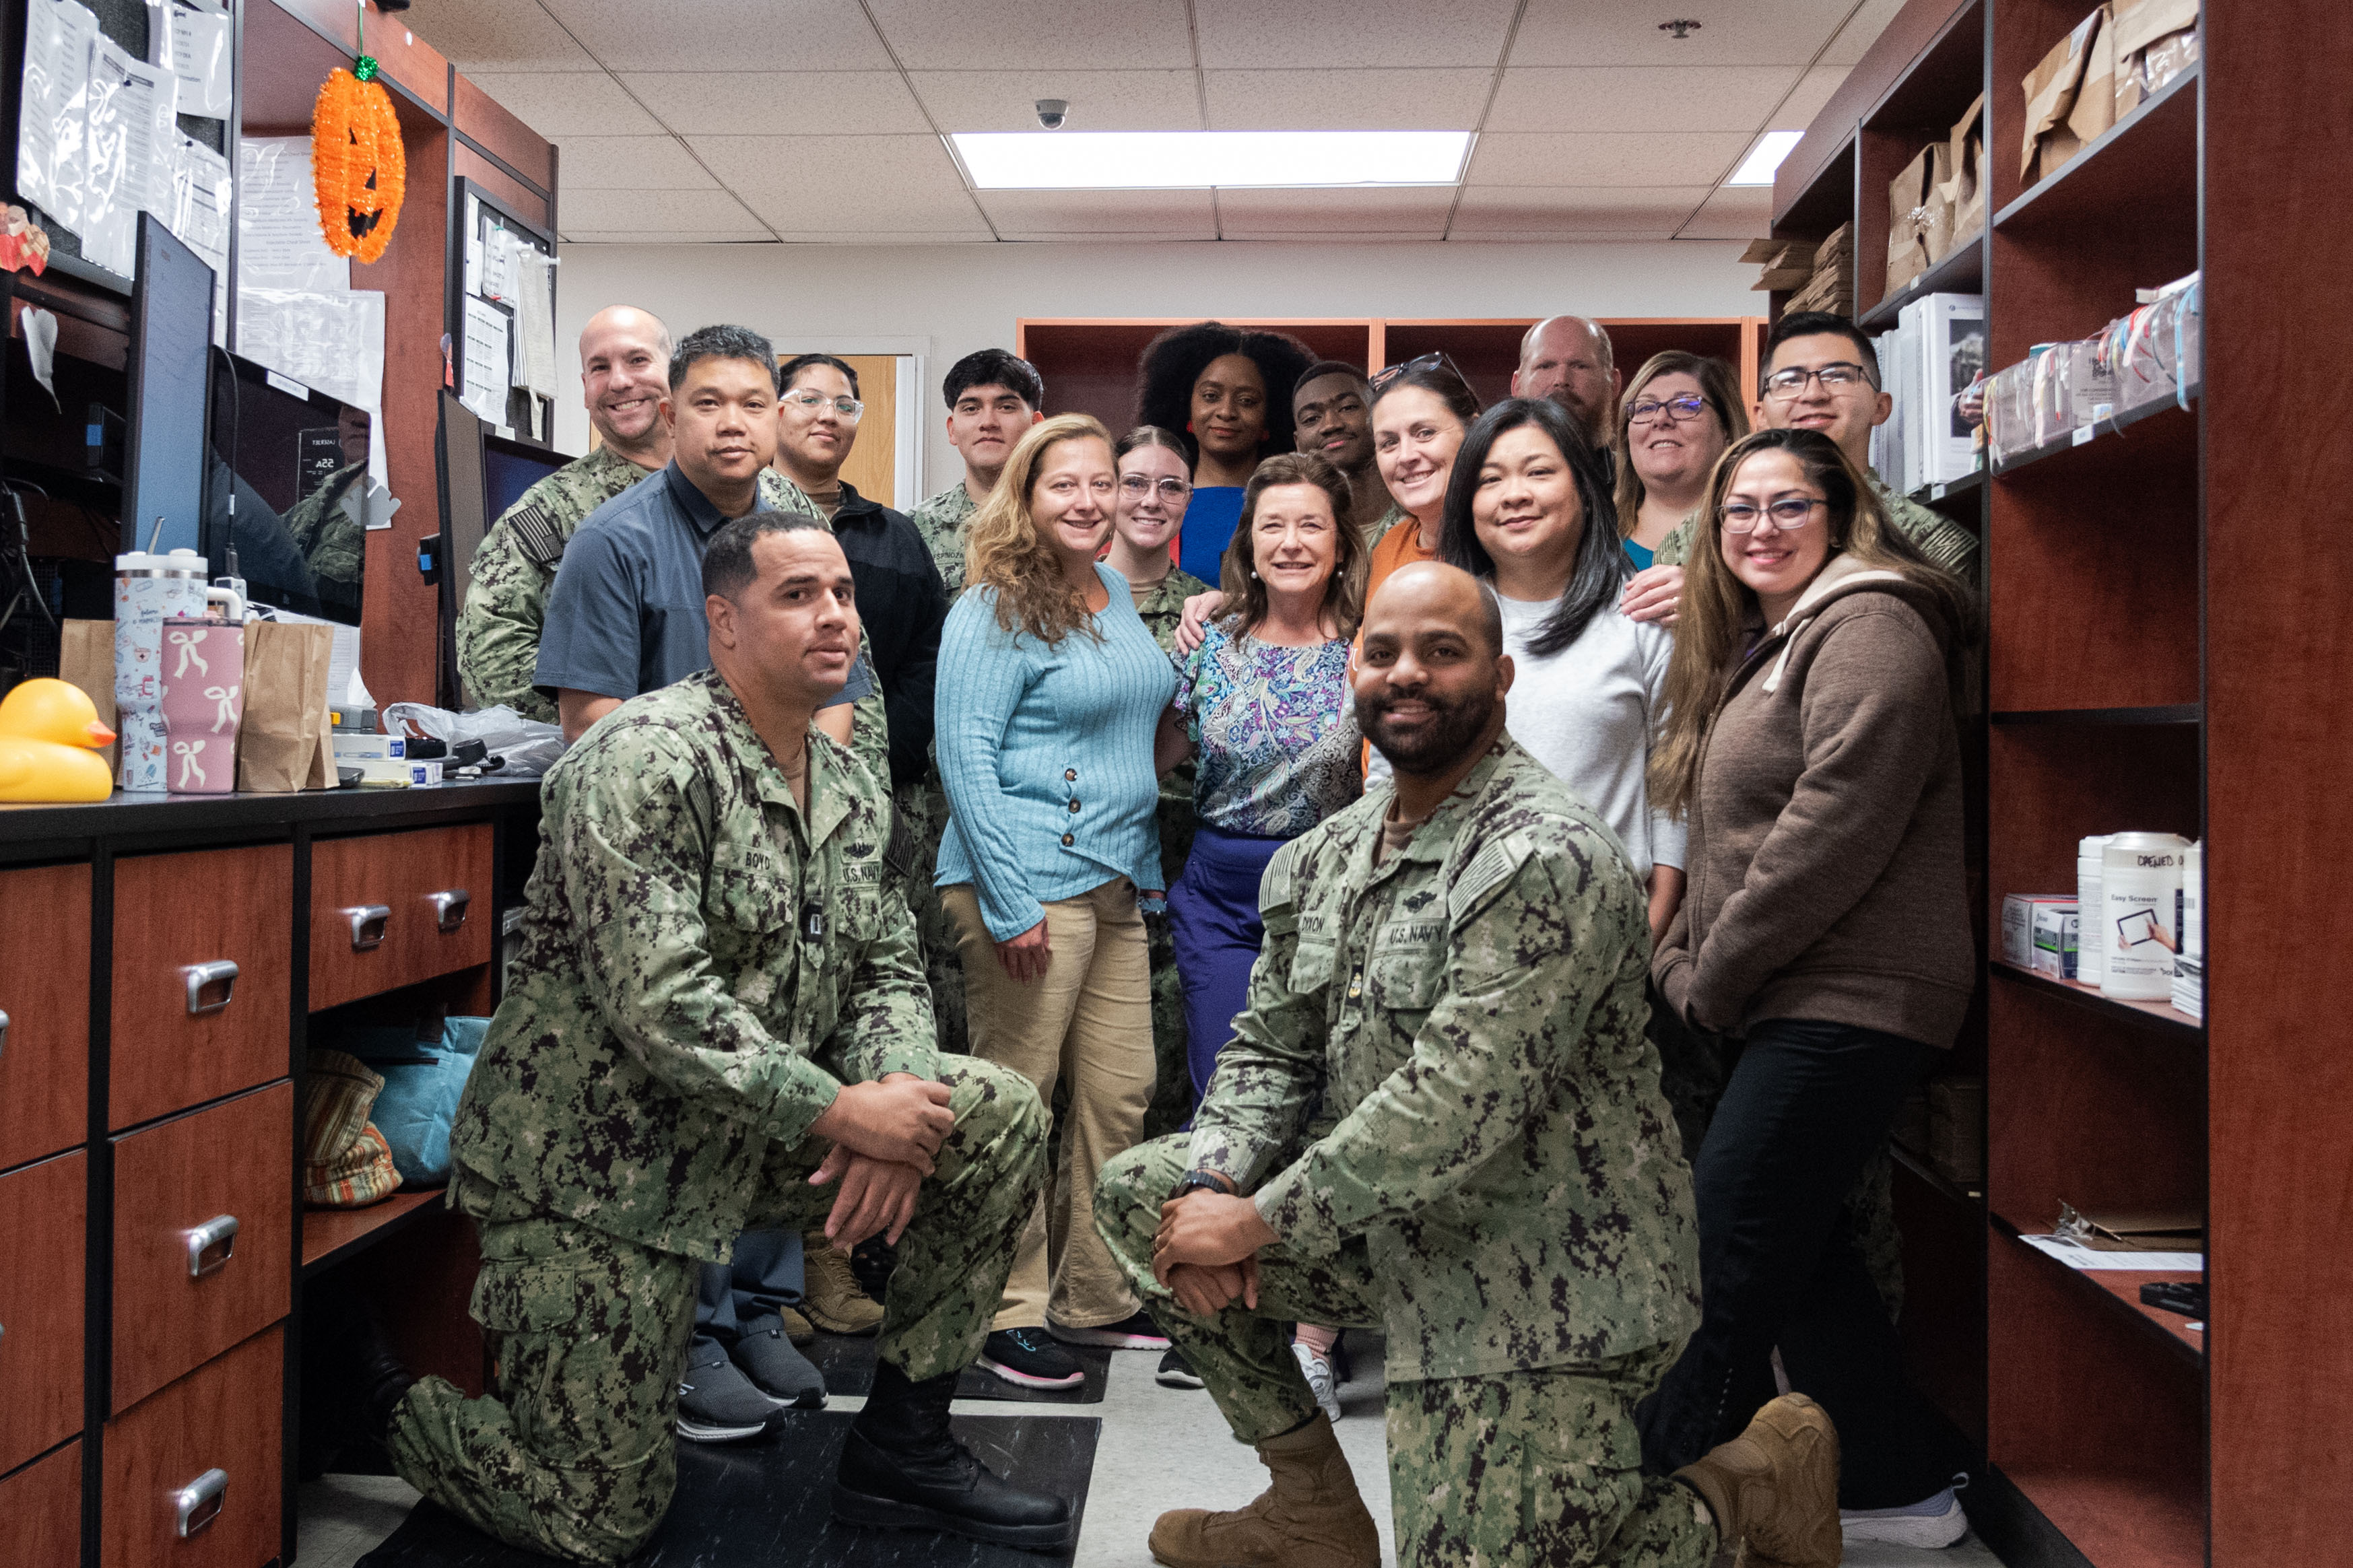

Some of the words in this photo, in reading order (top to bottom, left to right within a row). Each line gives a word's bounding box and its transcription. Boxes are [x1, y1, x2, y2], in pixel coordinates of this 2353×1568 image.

[933, 552, 964, 560] ESPINOZA
[745, 851, 770, 871] BOYD
[2137, 855, 2173, 868] OPENED
[842, 867, 861, 883] U.S.
[861, 866, 880, 881] NAVY
[2111, 893, 2126, 902] Easy
[2128, 894, 2158, 903] Screen
[1302, 916, 1325, 934] DIXON
[1390, 928, 1407, 945] U.S.
[1409, 925, 1444, 943] NAVY
